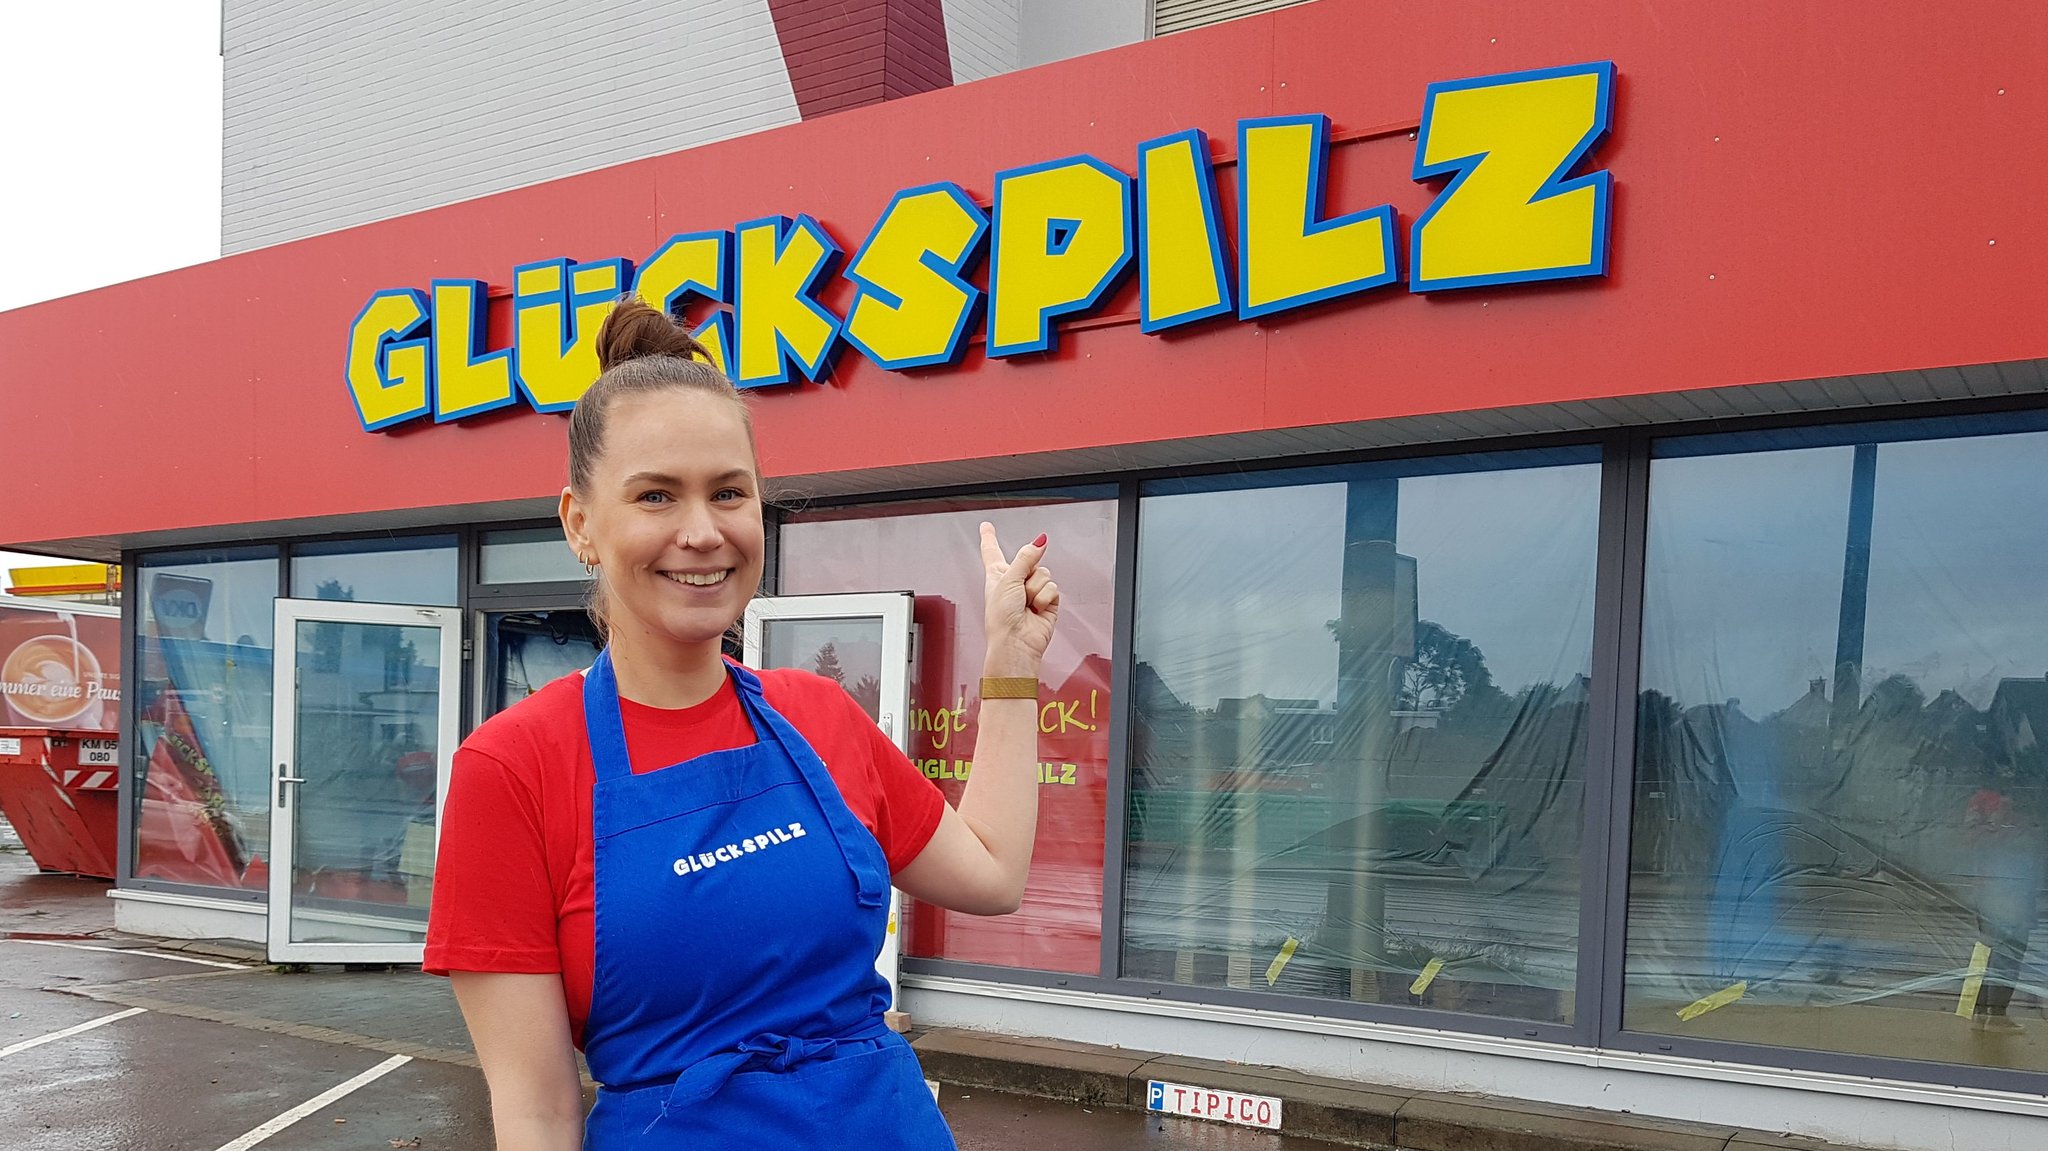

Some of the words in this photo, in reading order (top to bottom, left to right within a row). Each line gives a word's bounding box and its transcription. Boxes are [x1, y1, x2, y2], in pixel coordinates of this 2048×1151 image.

[345, 60, 1617, 434] GLÜCKSPILZ
[51, 680, 82, 698] eine
[82, 740, 101, 750] KM
[90, 752, 110, 762] 080
[672, 822, 807, 877] GLÜCKSPILZ
[1151, 1088, 1163, 1104] P
[1174, 1088, 1271, 1124] TIPICO
